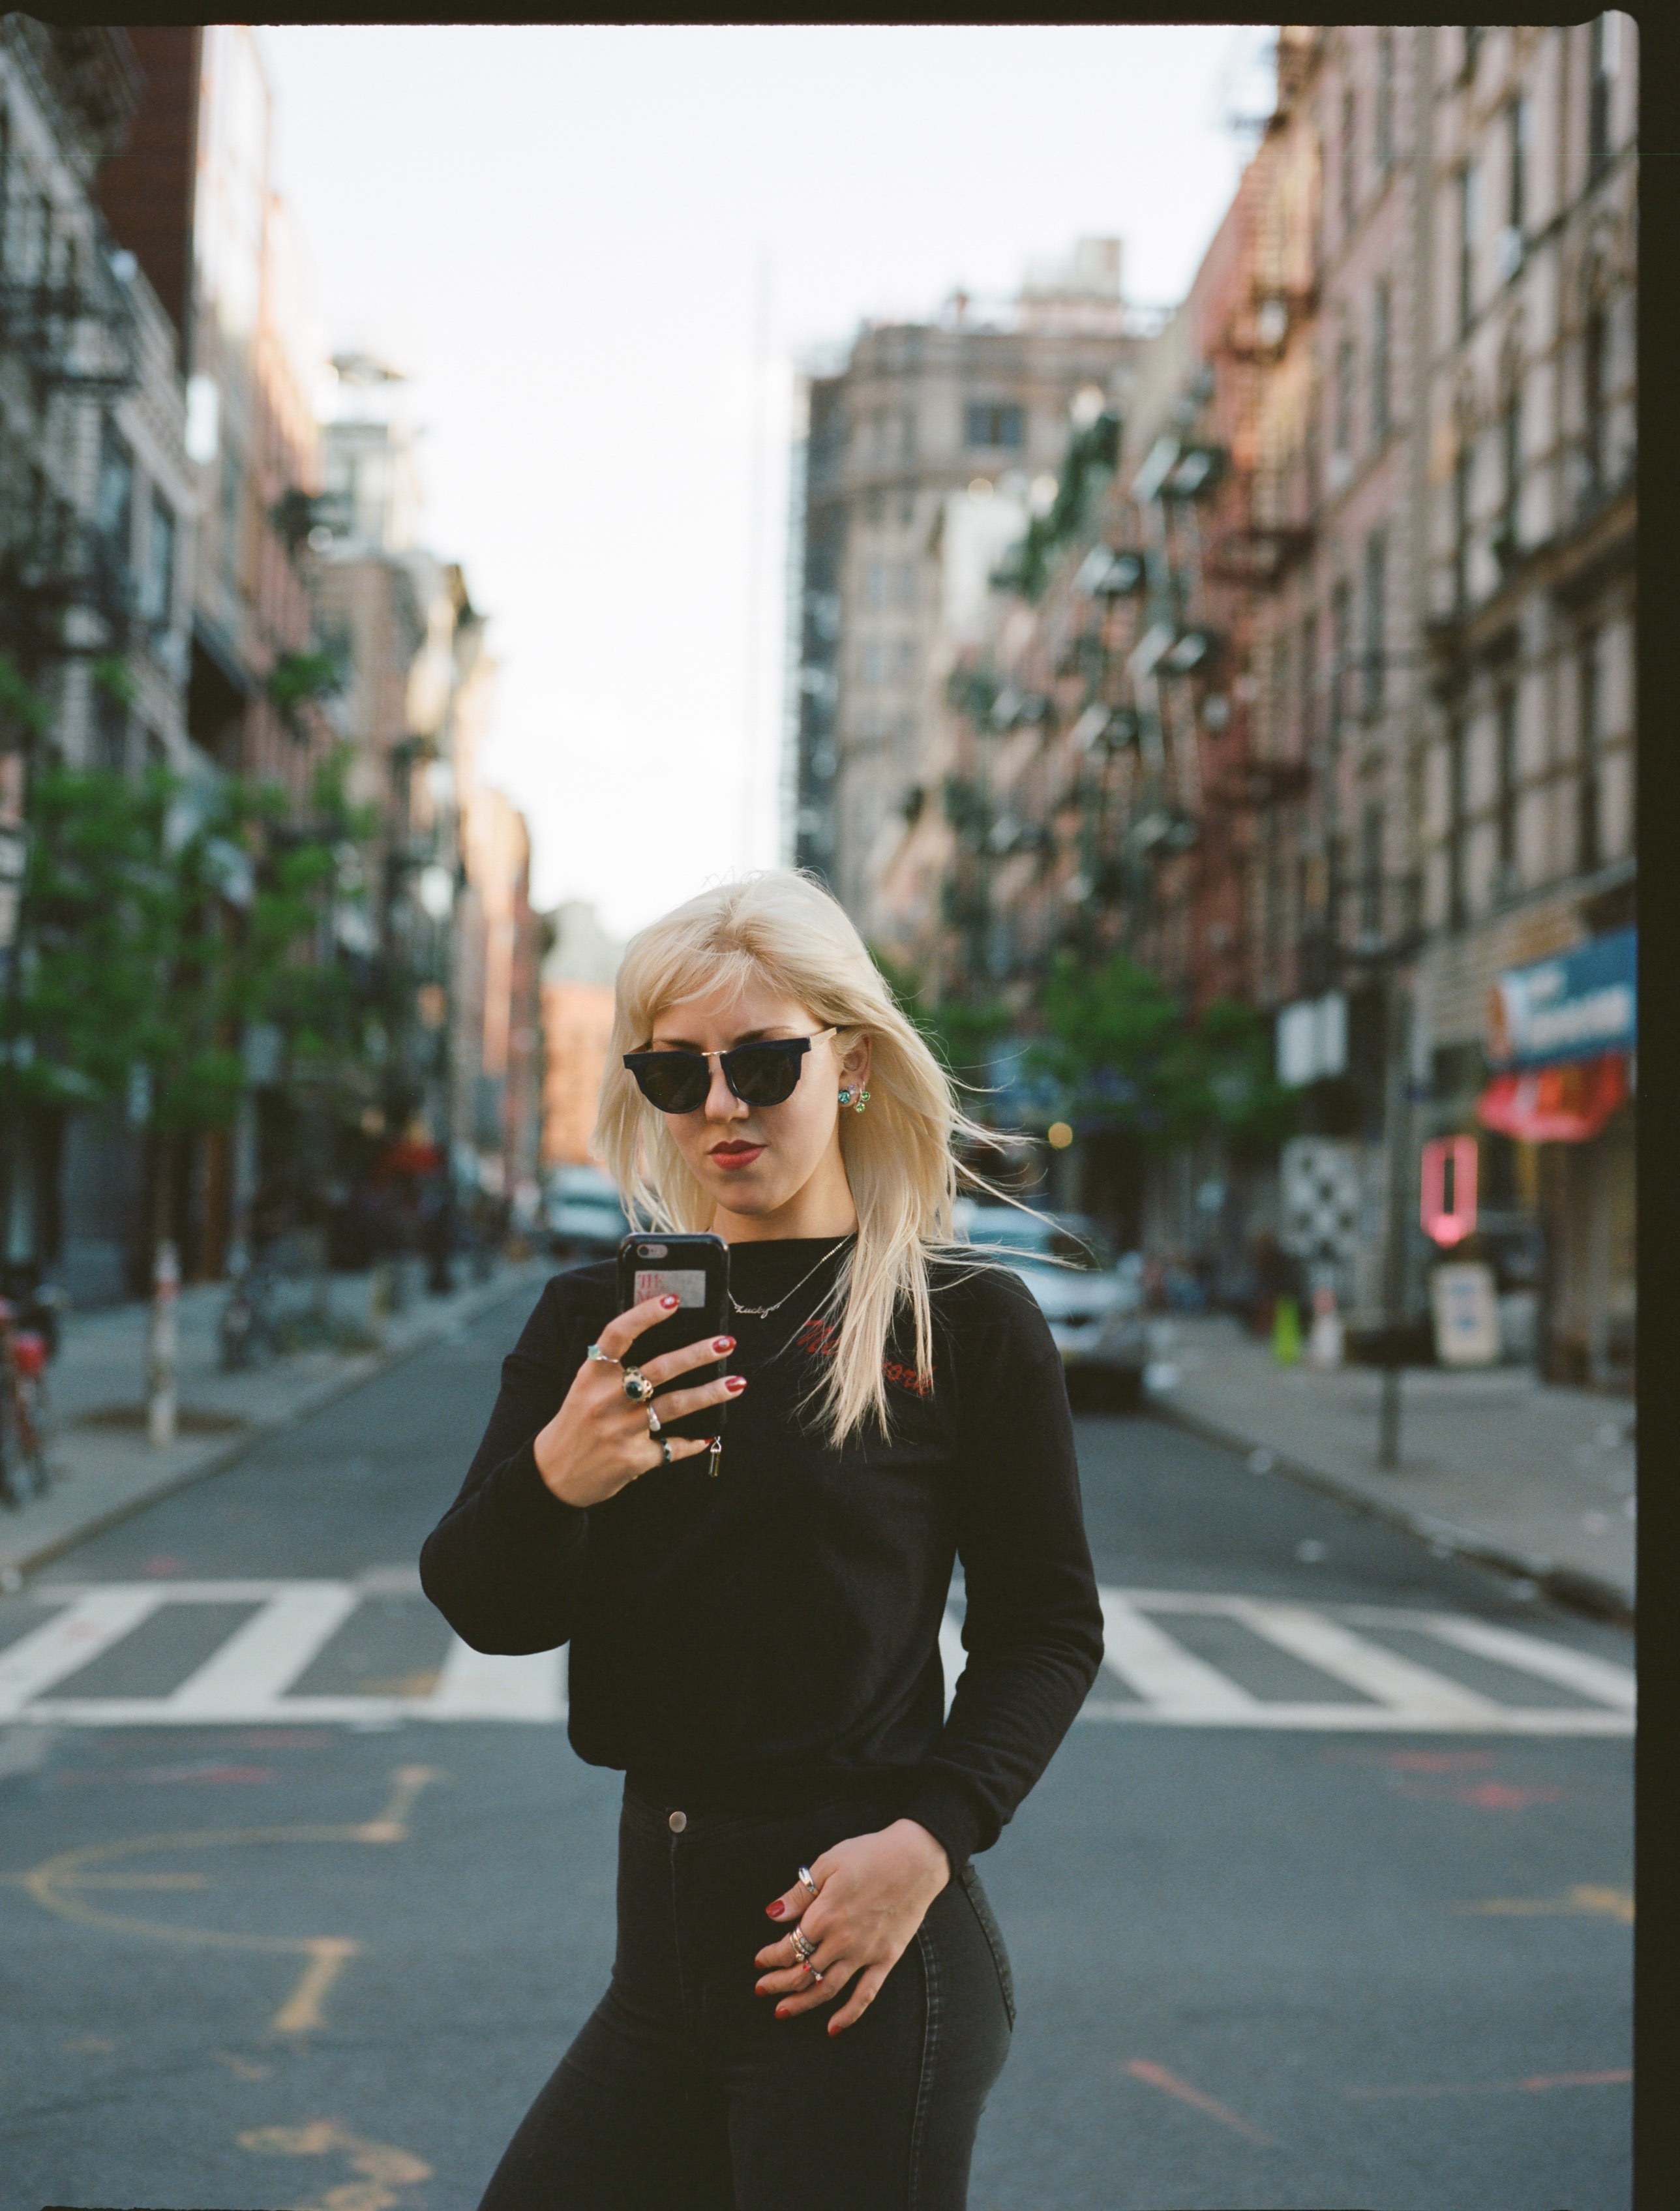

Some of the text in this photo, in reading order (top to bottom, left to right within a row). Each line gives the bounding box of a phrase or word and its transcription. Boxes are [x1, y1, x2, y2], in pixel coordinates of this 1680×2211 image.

[734, 1304, 770, 1319] Lucky
[796, 1319, 937, 1395] Ne ork
